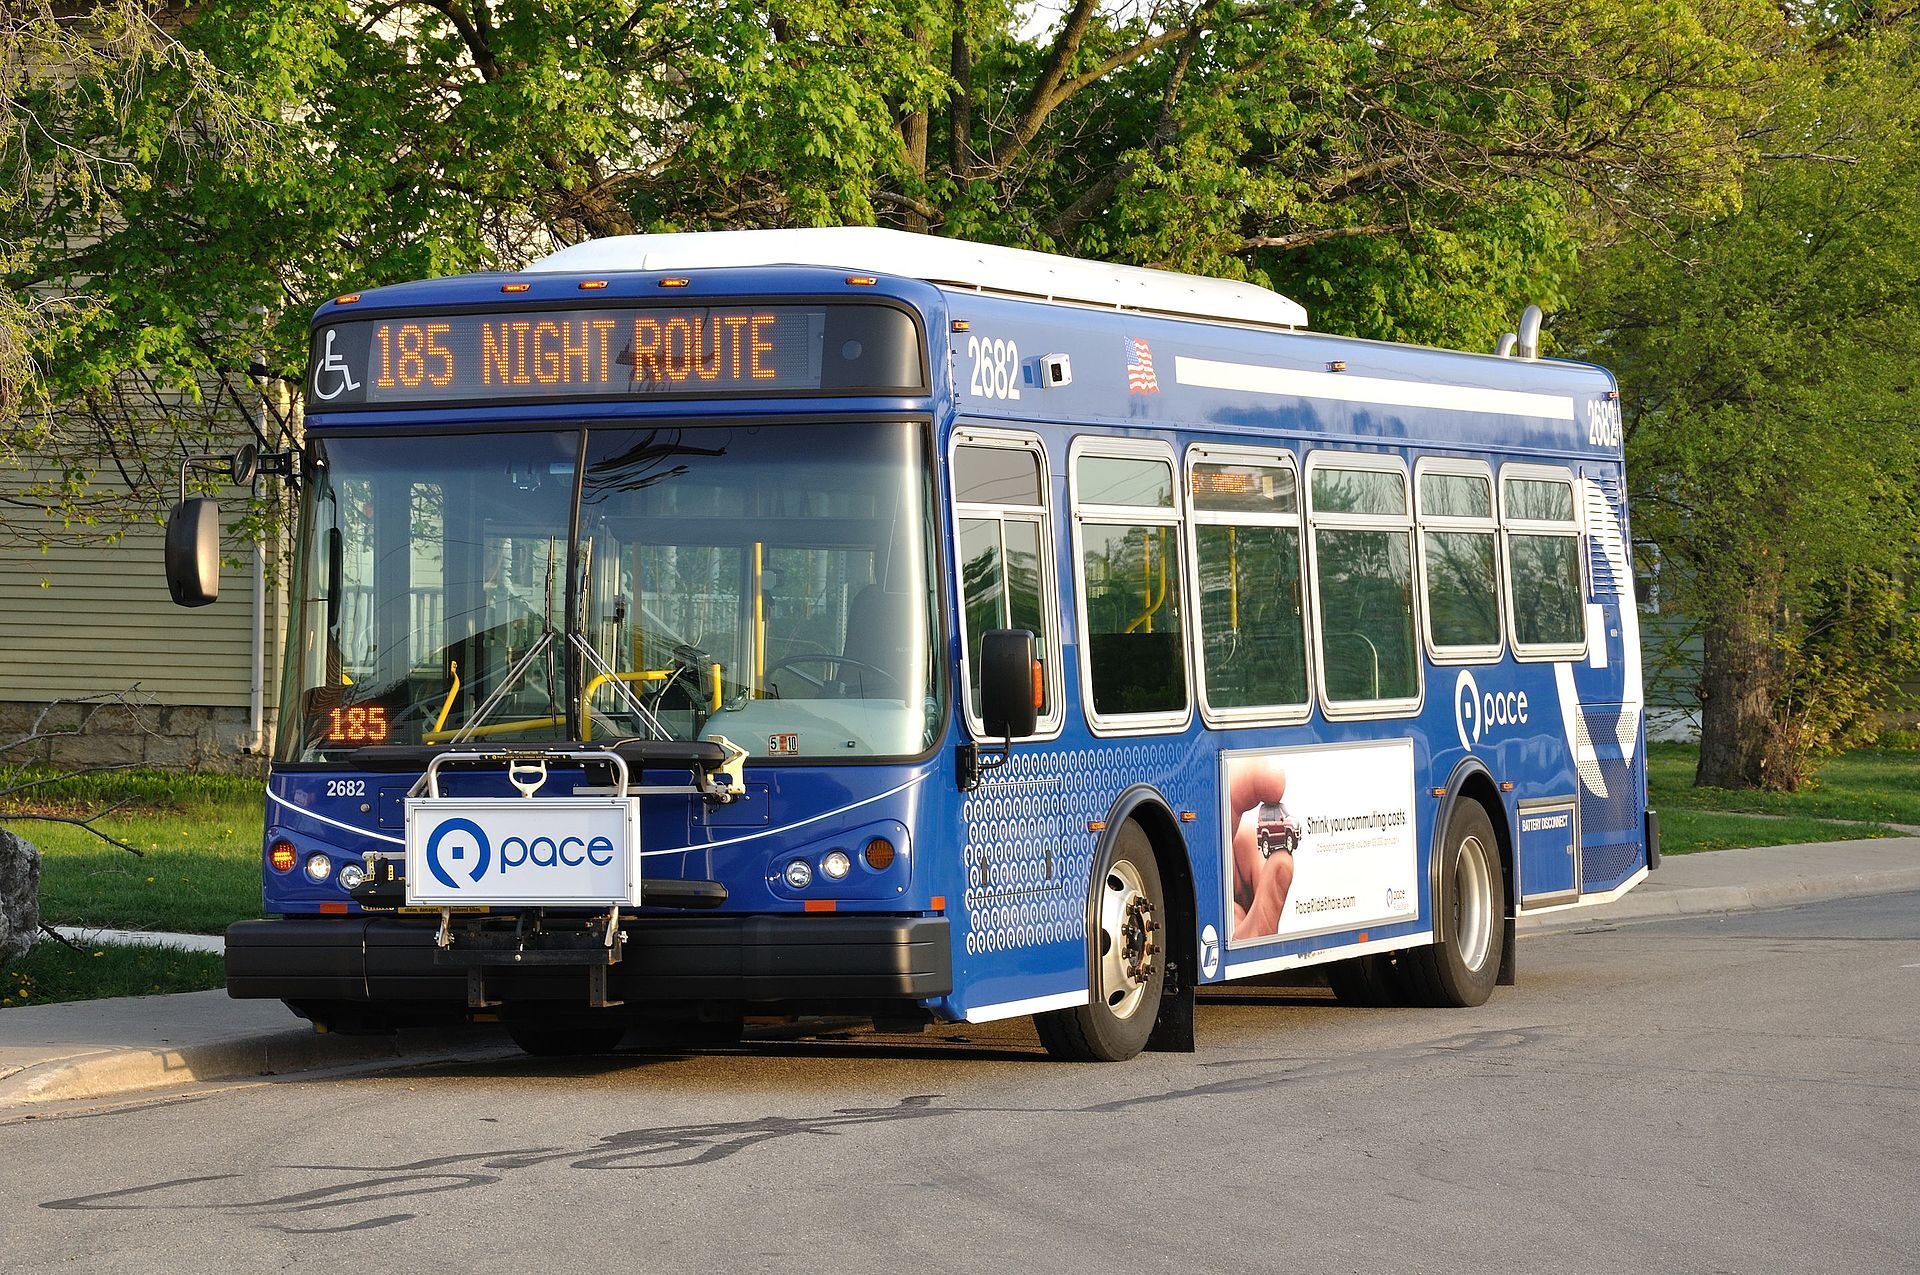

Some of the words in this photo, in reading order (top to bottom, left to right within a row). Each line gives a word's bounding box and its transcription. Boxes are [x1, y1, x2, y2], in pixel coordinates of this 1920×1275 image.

[377, 323, 454, 388] 185
[482, 320, 616, 385] NIGHT
[635, 315, 776, 381] ROUTE
[967, 335, 1021, 401] 2682
[1587, 399, 1618, 447] 2682
[329, 707, 387, 740] 185
[1483, 690, 1529, 735] pace
[769, 736, 777, 750] 5
[787, 736, 797, 751] 10
[326, 779, 366, 797] 2682
[1306, 815, 1329, 835] Shrink
[1329, 817, 1346, 837] your
[1346, 810, 1387, 832] commuting
[1521, 818, 1541, 832] BATTERY
[1541, 814, 1569, 830] DISCONNECT
[499, 836, 615, 874] pace
[1294, 895, 1357, 916] PaceRideShare.com
